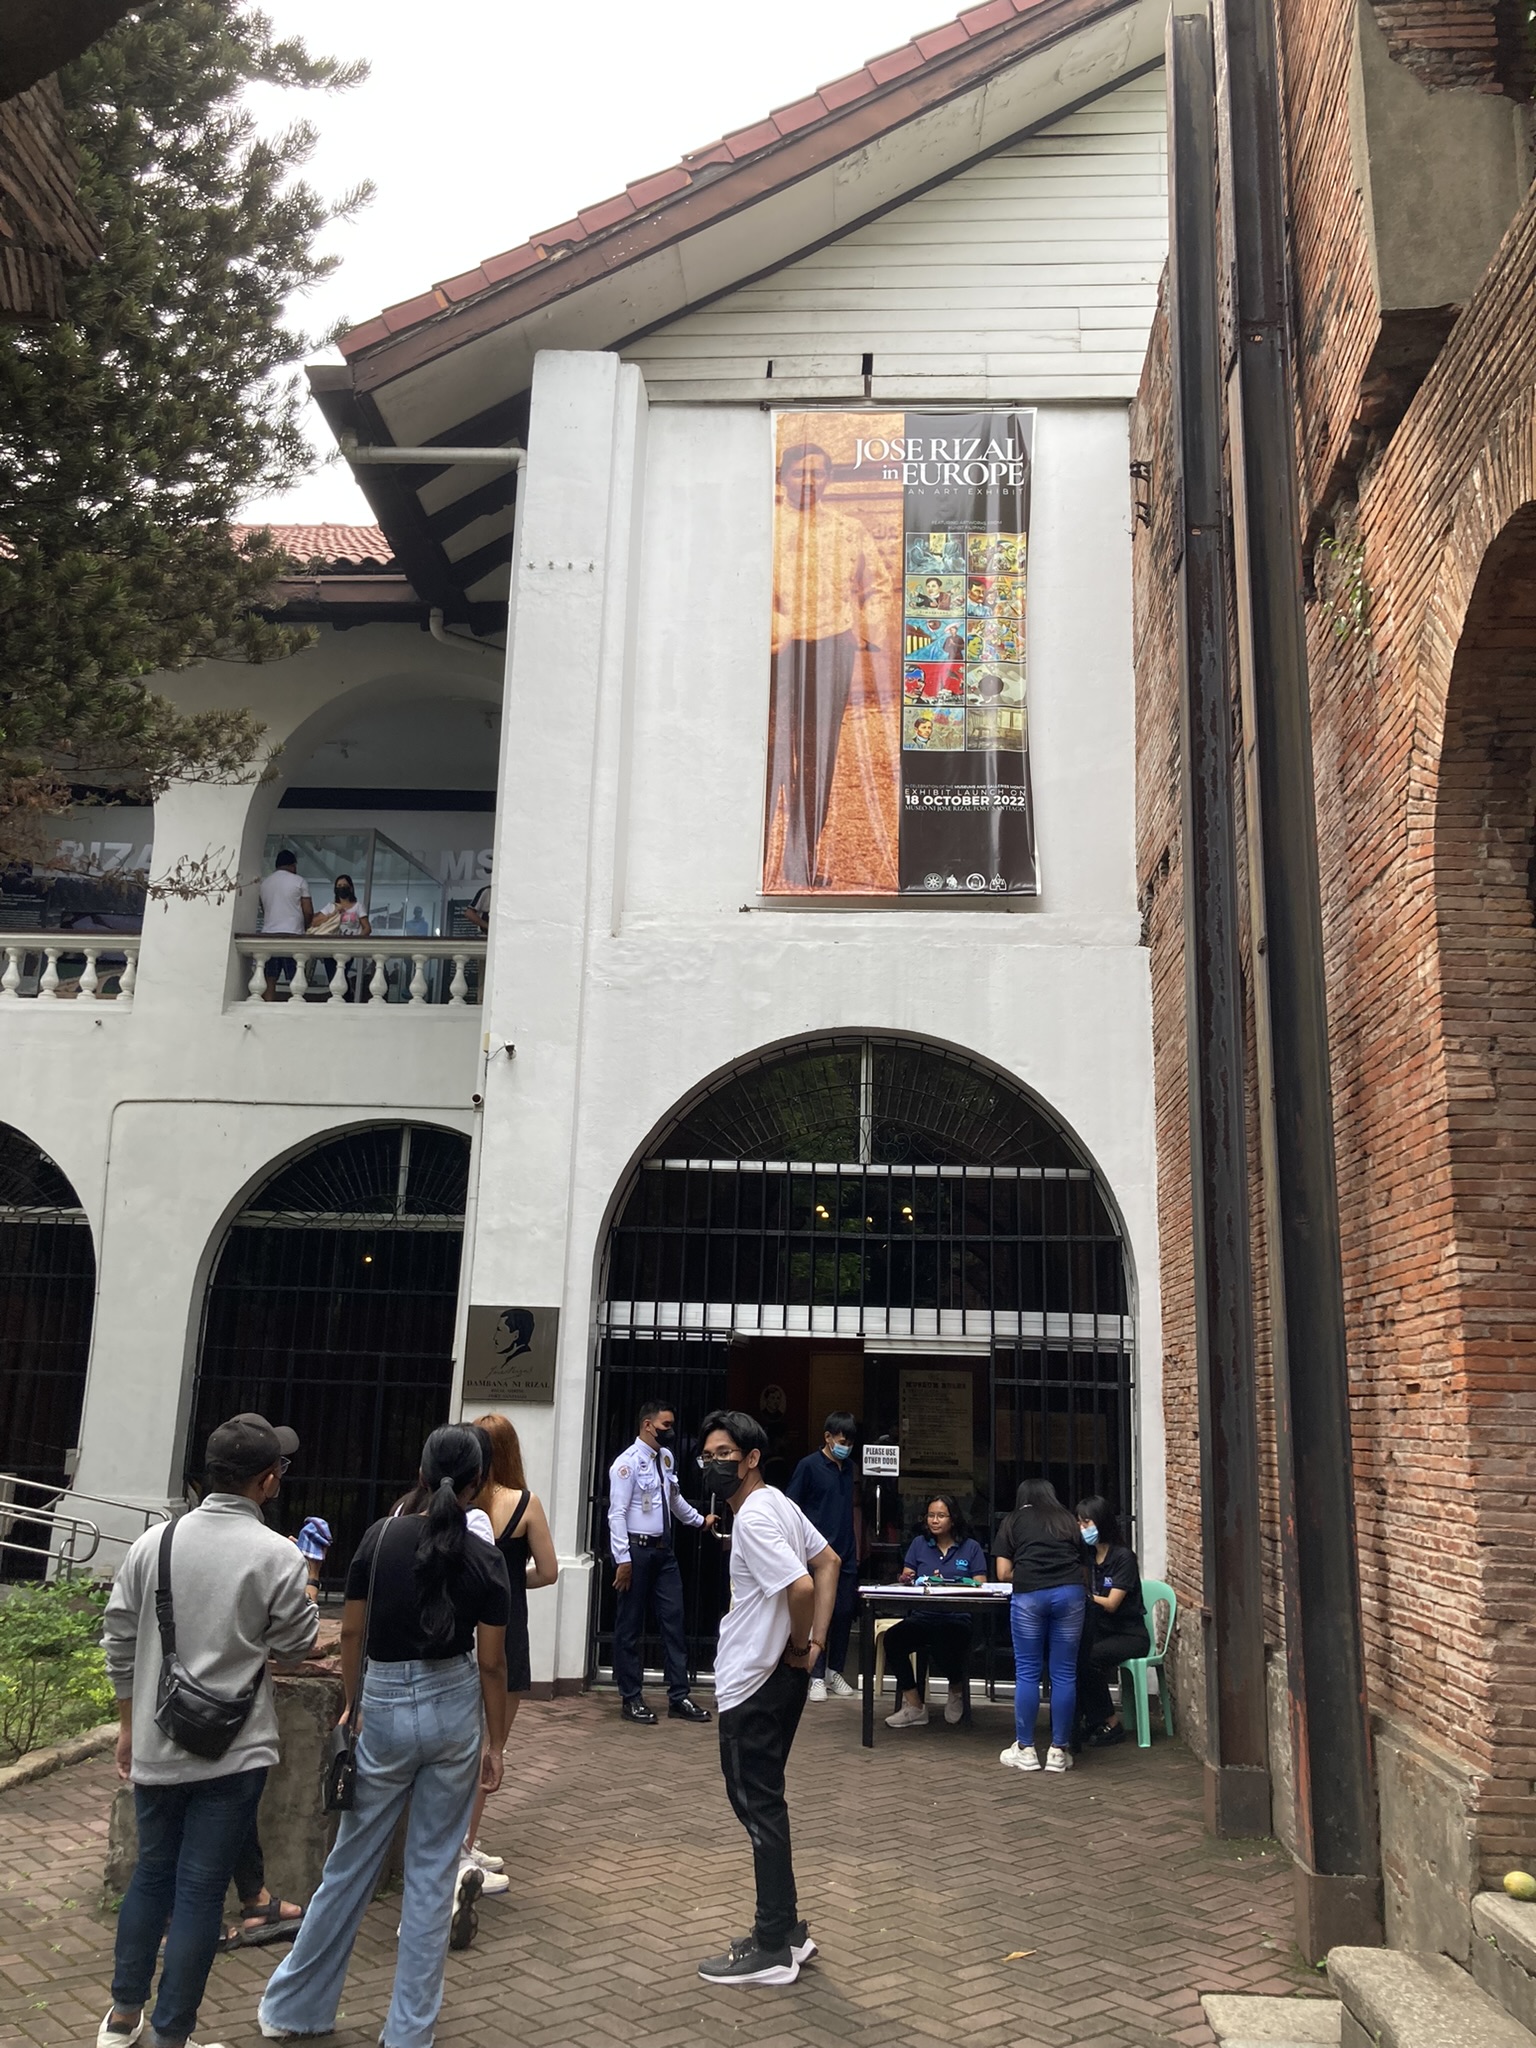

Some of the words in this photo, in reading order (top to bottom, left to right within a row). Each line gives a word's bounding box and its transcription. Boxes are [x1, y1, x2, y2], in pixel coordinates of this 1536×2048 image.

[853, 438, 923, 469] JOSE
[929, 438, 1023, 461] RIZAL
[882, 464, 899, 480] in
[902, 462, 1025, 486] EUROPE
[968, 488, 1024, 496] EXHIBIT
[904, 788, 951, 796] EXHIBIT
[905, 795, 919, 805] 18
[922, 795, 990, 806] OCTOBER
[993, 795, 1025, 806] 2022
[866, 1447, 885, 1455] PLEASE
[886, 1448, 896, 1456] USE
[864, 1456, 881, 1464] OTHER
[882, 1457, 897, 1465] DOOR
